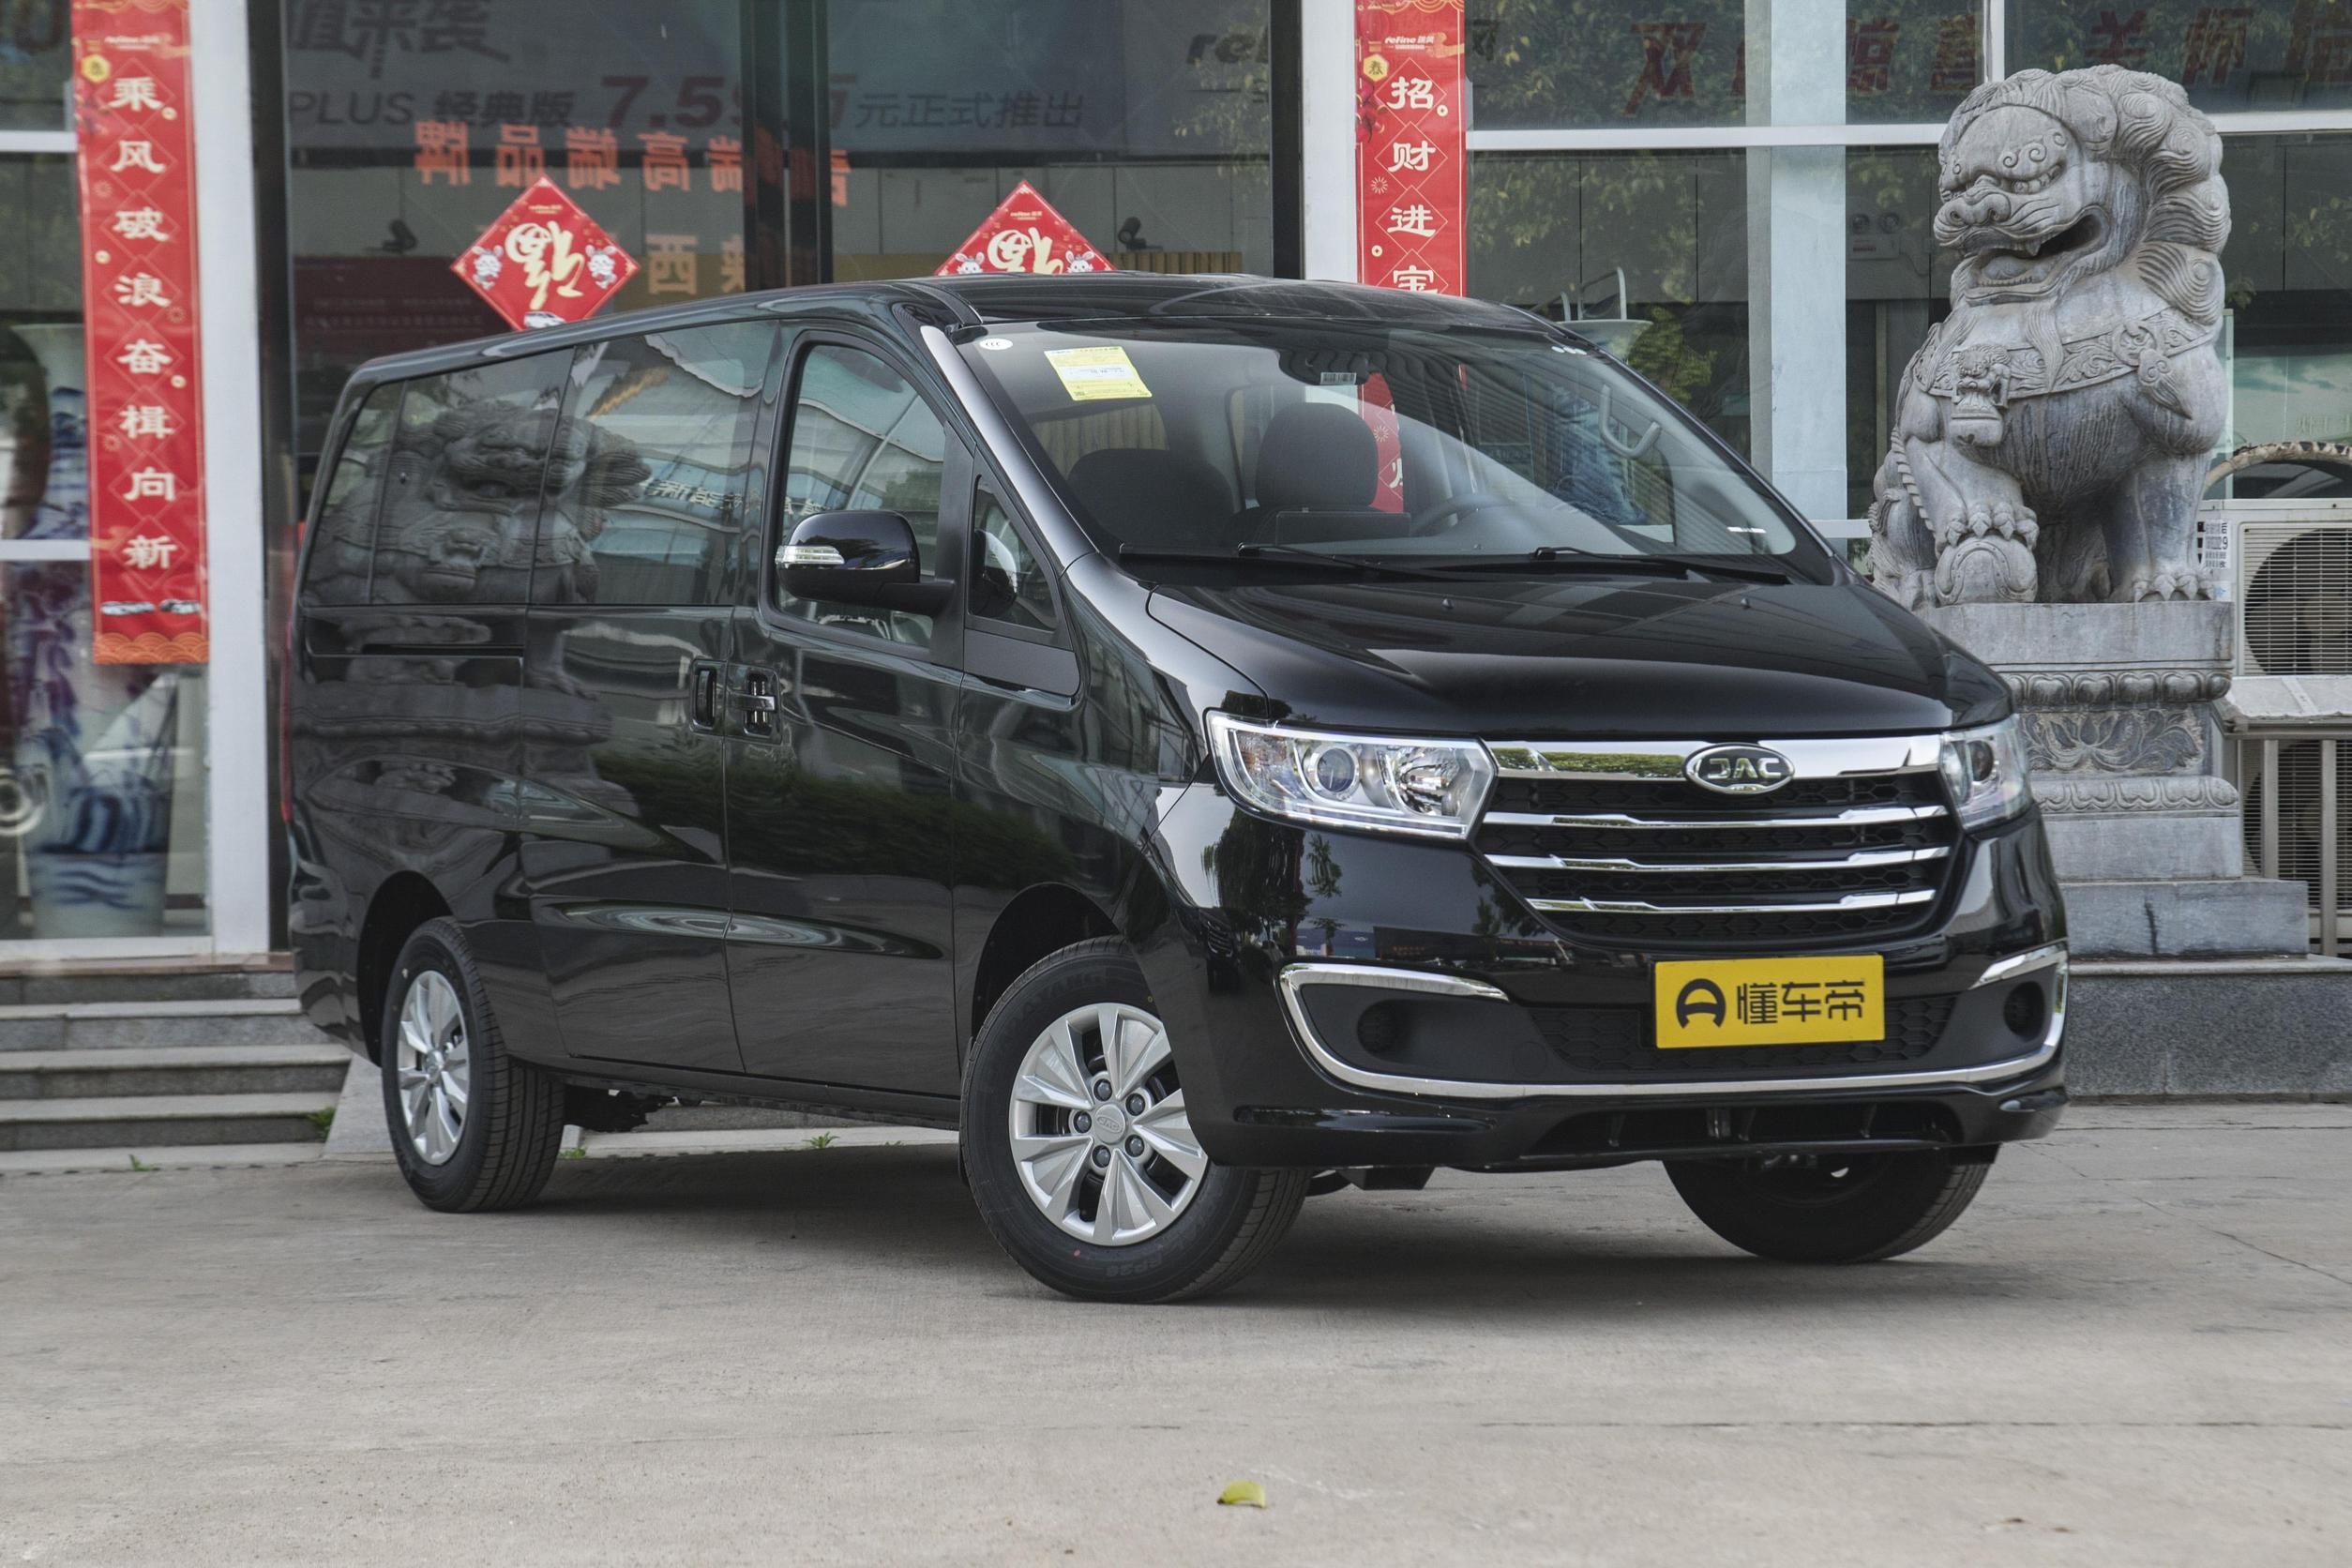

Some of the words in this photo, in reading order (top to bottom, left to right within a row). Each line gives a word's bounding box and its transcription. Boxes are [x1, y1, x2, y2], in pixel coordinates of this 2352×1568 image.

[1386, 76, 1439, 293] 招财进宝
[1707, 757, 1782, 779] JAC
[1737, 980, 1864, 1024] 懂车帝
